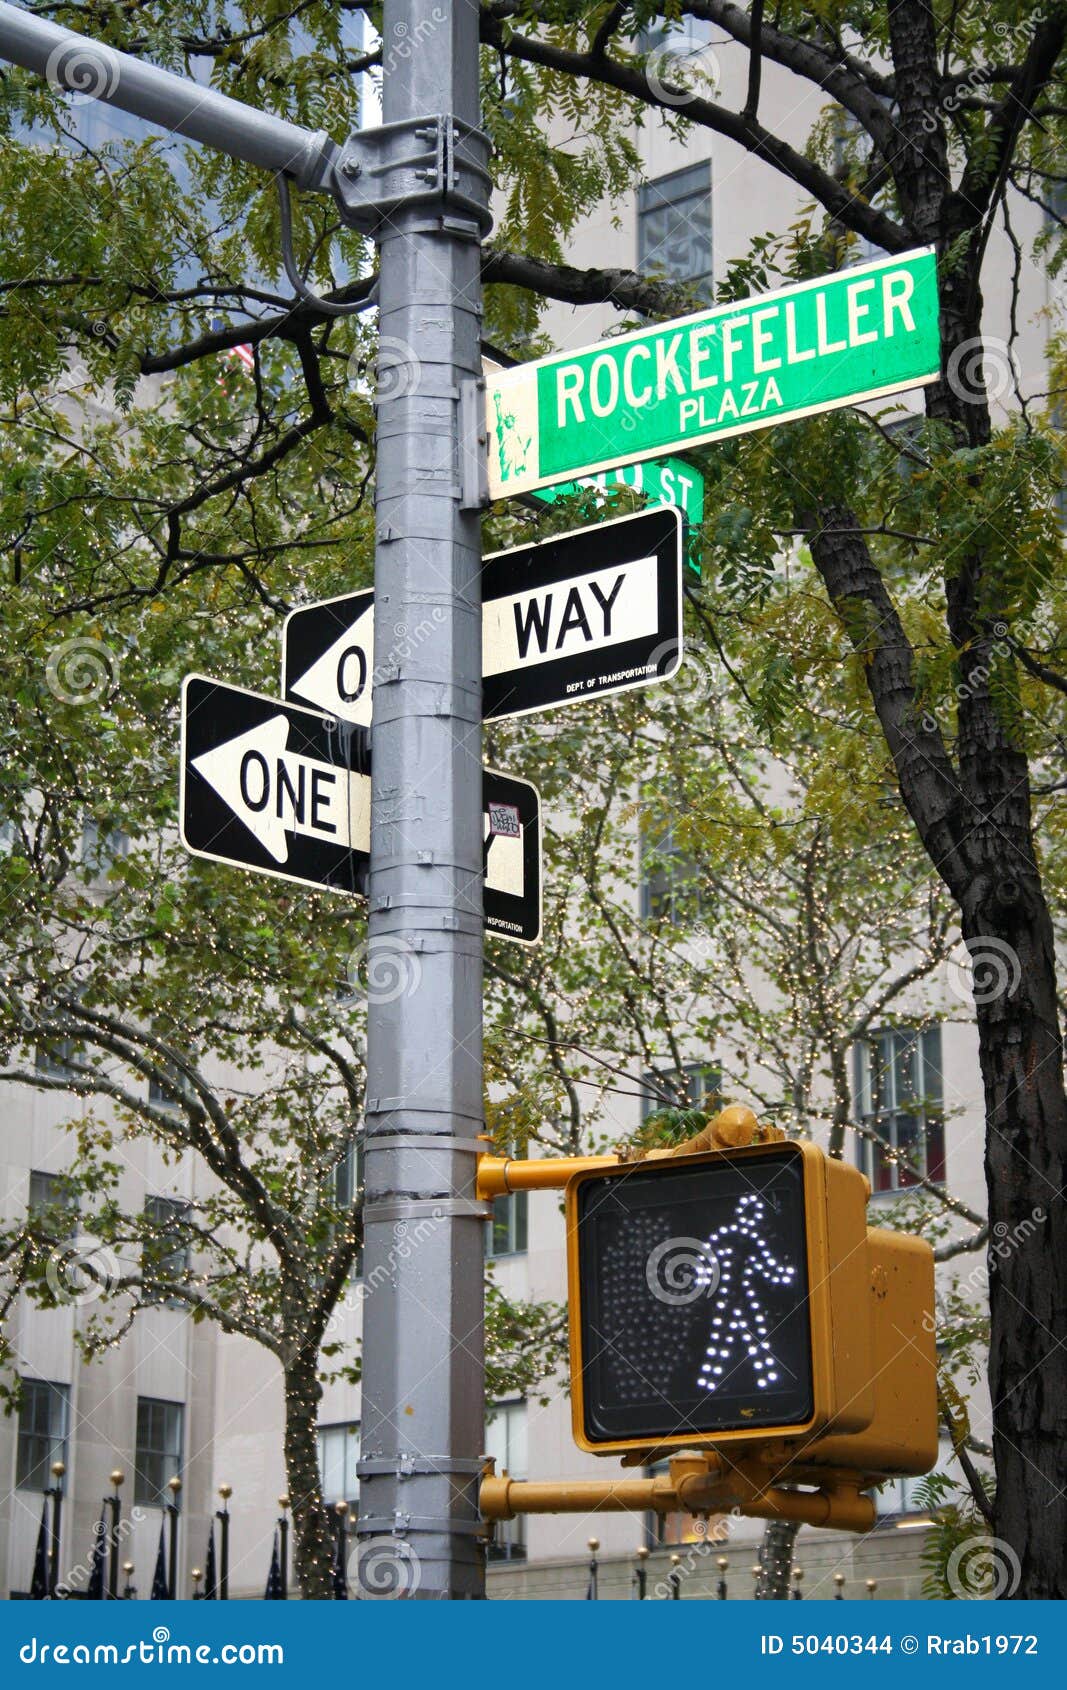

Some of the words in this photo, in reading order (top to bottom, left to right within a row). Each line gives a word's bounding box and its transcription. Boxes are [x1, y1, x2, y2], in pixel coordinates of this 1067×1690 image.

[555, 269, 917, 429] ROCKEFELLER
[679, 376, 784, 433] PLAZA
[659, 467, 693, 512] ST
[512, 573, 627, 660] WAY
[586, 678, 596, 688] OF
[598, 663, 658, 686] TRANSPORTATION
[238, 748, 338, 835] ONE
[487, 916, 523, 933] NSPORTATION
